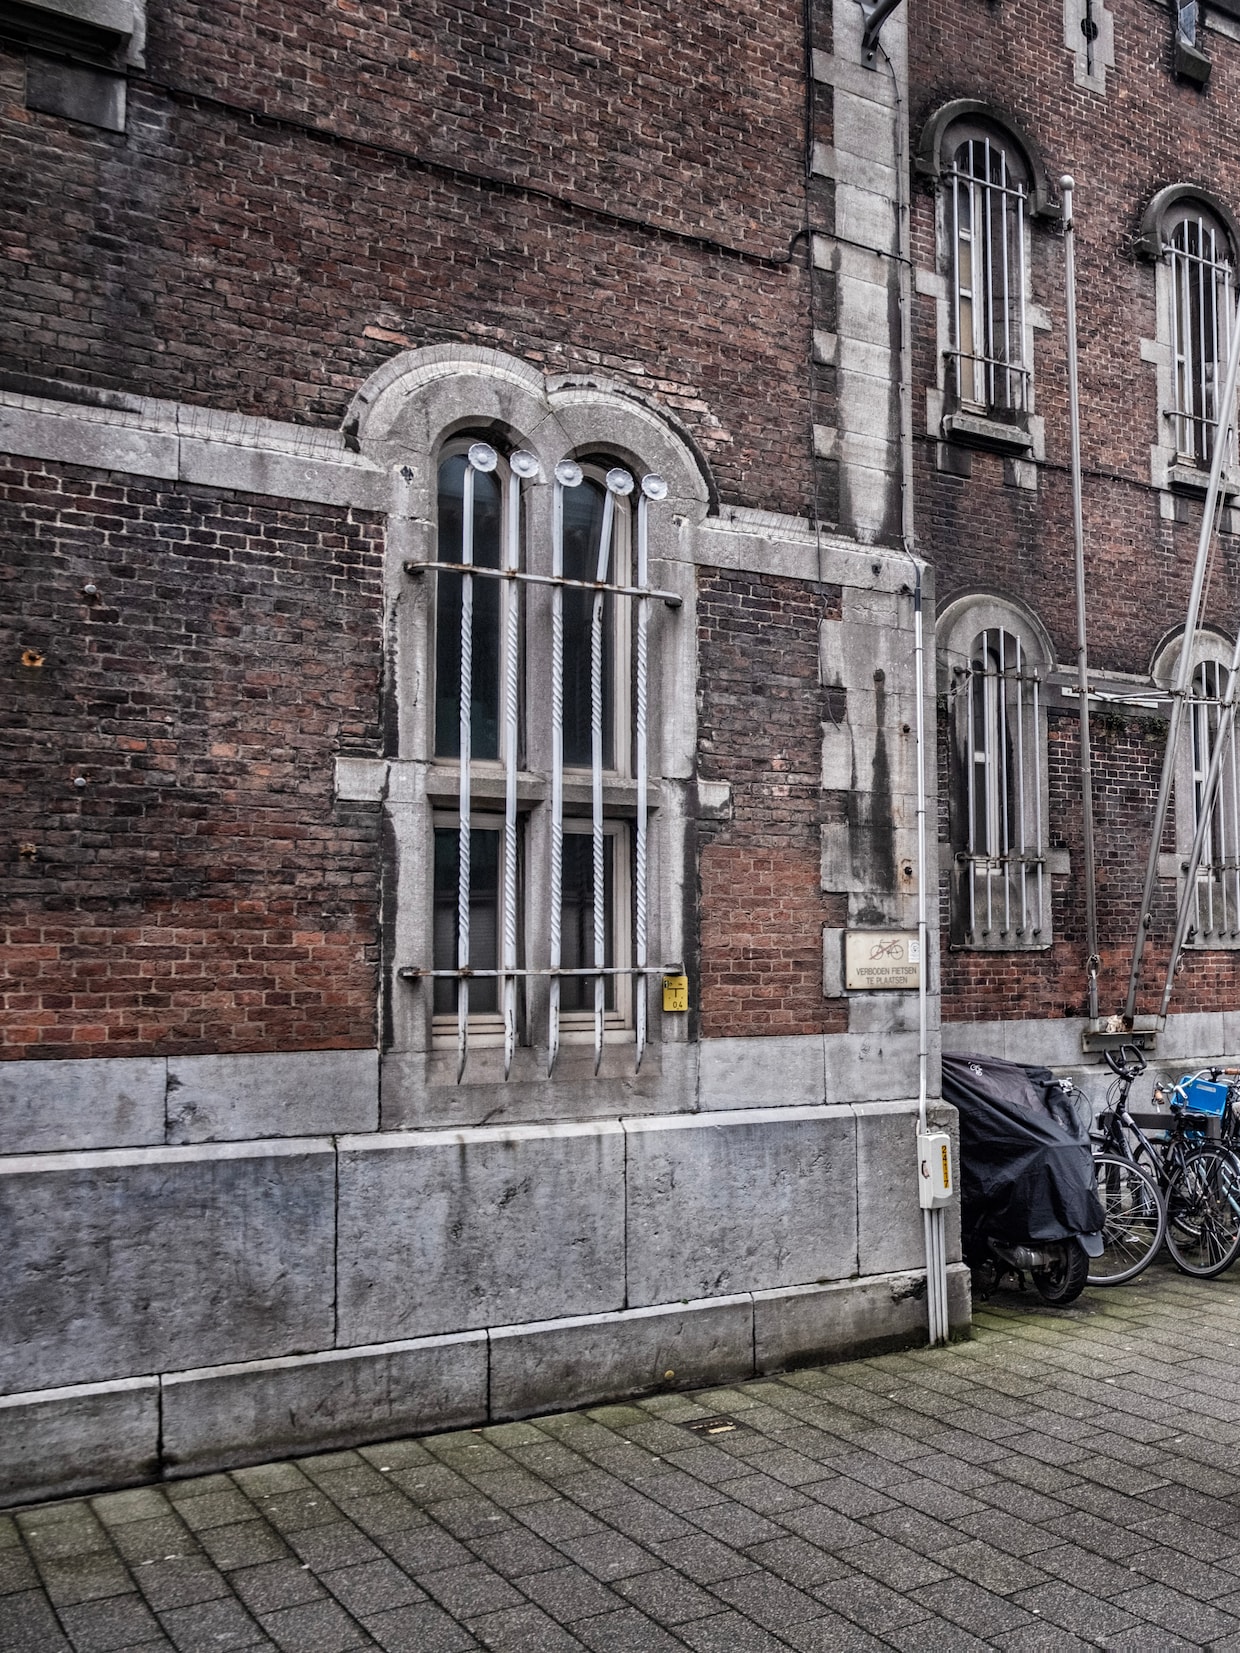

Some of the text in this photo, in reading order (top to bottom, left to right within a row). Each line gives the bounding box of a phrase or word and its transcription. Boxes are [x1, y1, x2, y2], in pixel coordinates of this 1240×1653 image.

[856, 966, 917, 975] VERBODEN FIETSEN
[876, 976, 908, 984] PLAATSEN
